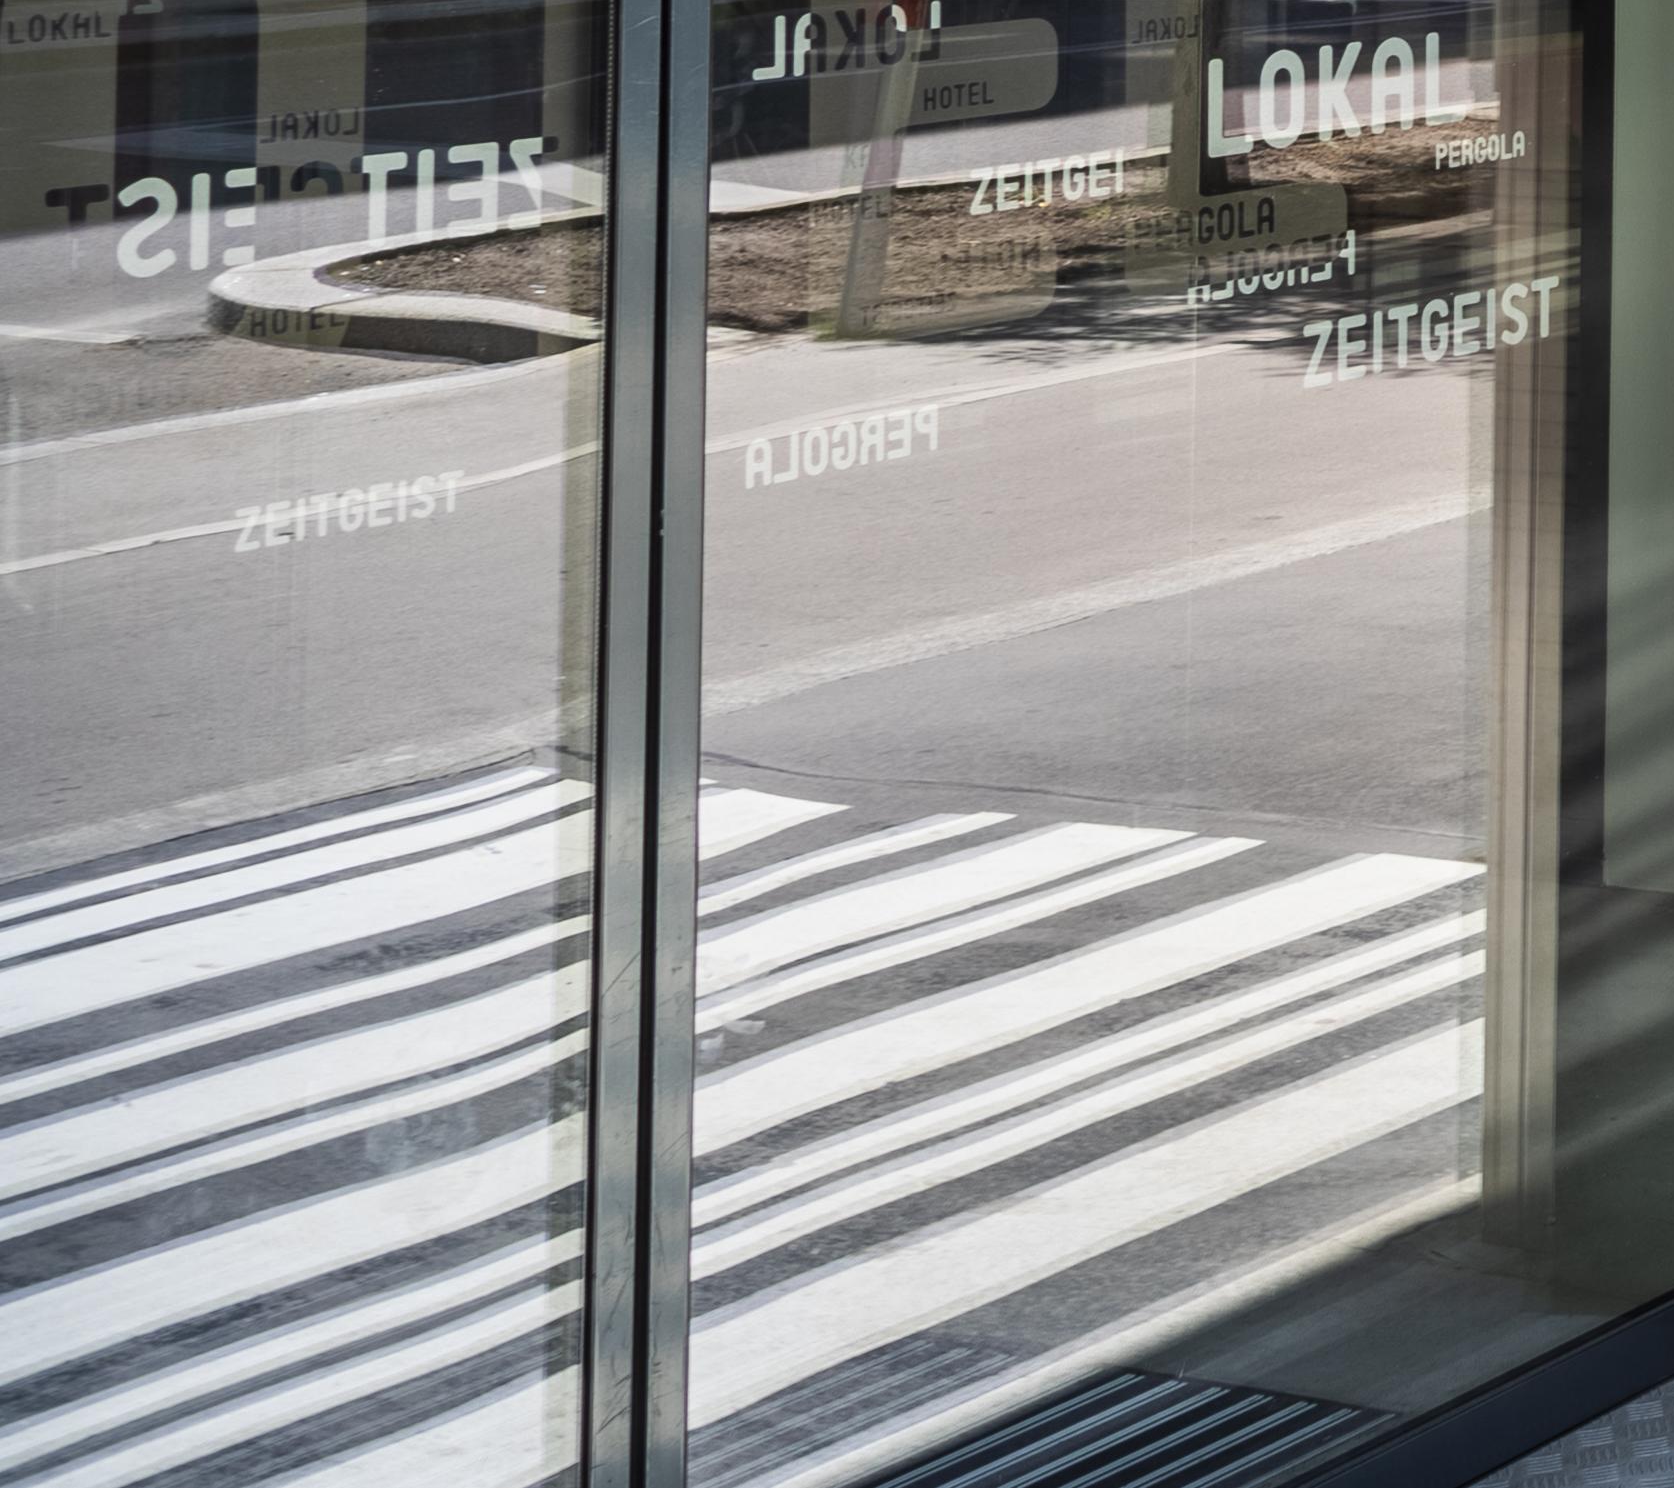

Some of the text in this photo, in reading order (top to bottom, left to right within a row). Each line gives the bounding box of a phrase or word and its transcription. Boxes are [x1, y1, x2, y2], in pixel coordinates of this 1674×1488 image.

[923, 81, 995, 112] HOTEL
[1207, 32, 1467, 159] LOKAL
[1434, 130, 1527, 170] PERGOLA
[1301, 275, 1561, 389] ZEITGEIST
[233, 469, 466, 554] ZEITGEIST
